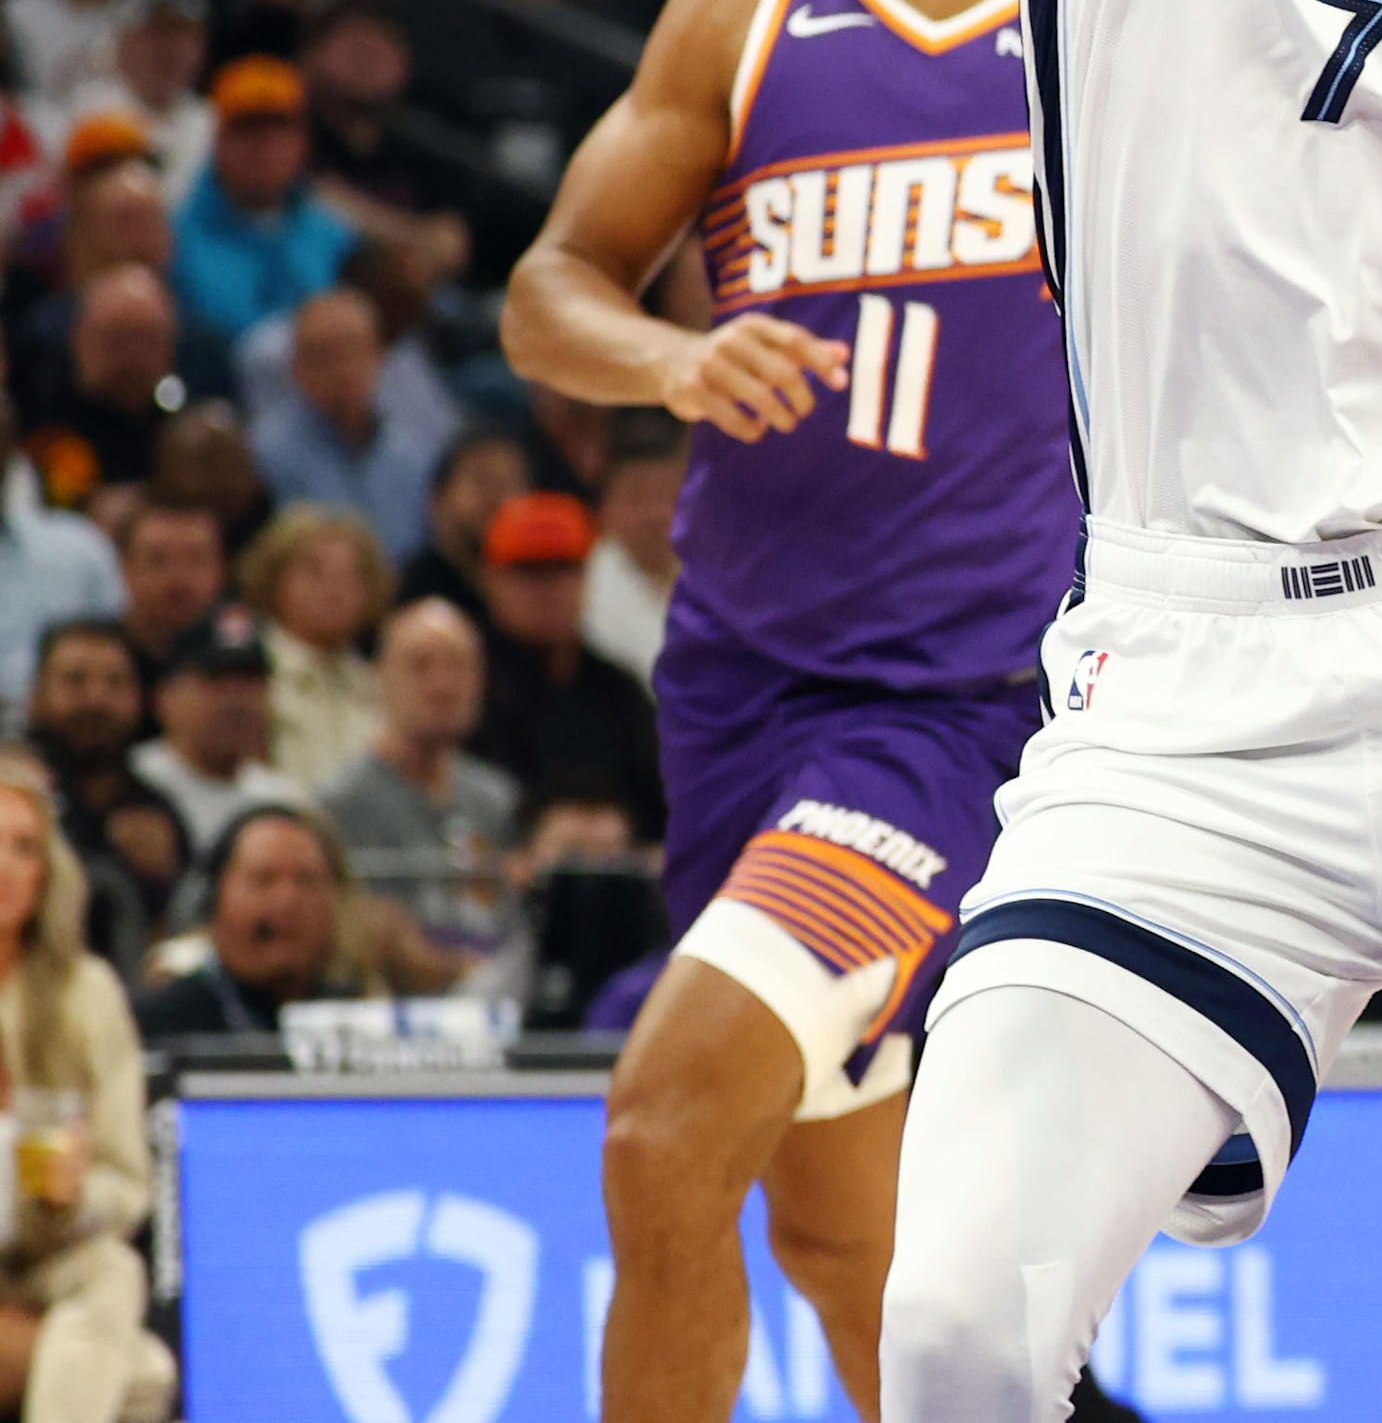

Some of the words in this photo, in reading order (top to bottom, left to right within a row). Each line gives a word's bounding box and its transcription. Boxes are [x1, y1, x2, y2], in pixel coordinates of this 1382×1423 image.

[745, 147, 1036, 293] SUNS
[846, 293, 938, 460] 11
[776, 799, 948, 891] PHOENIX
